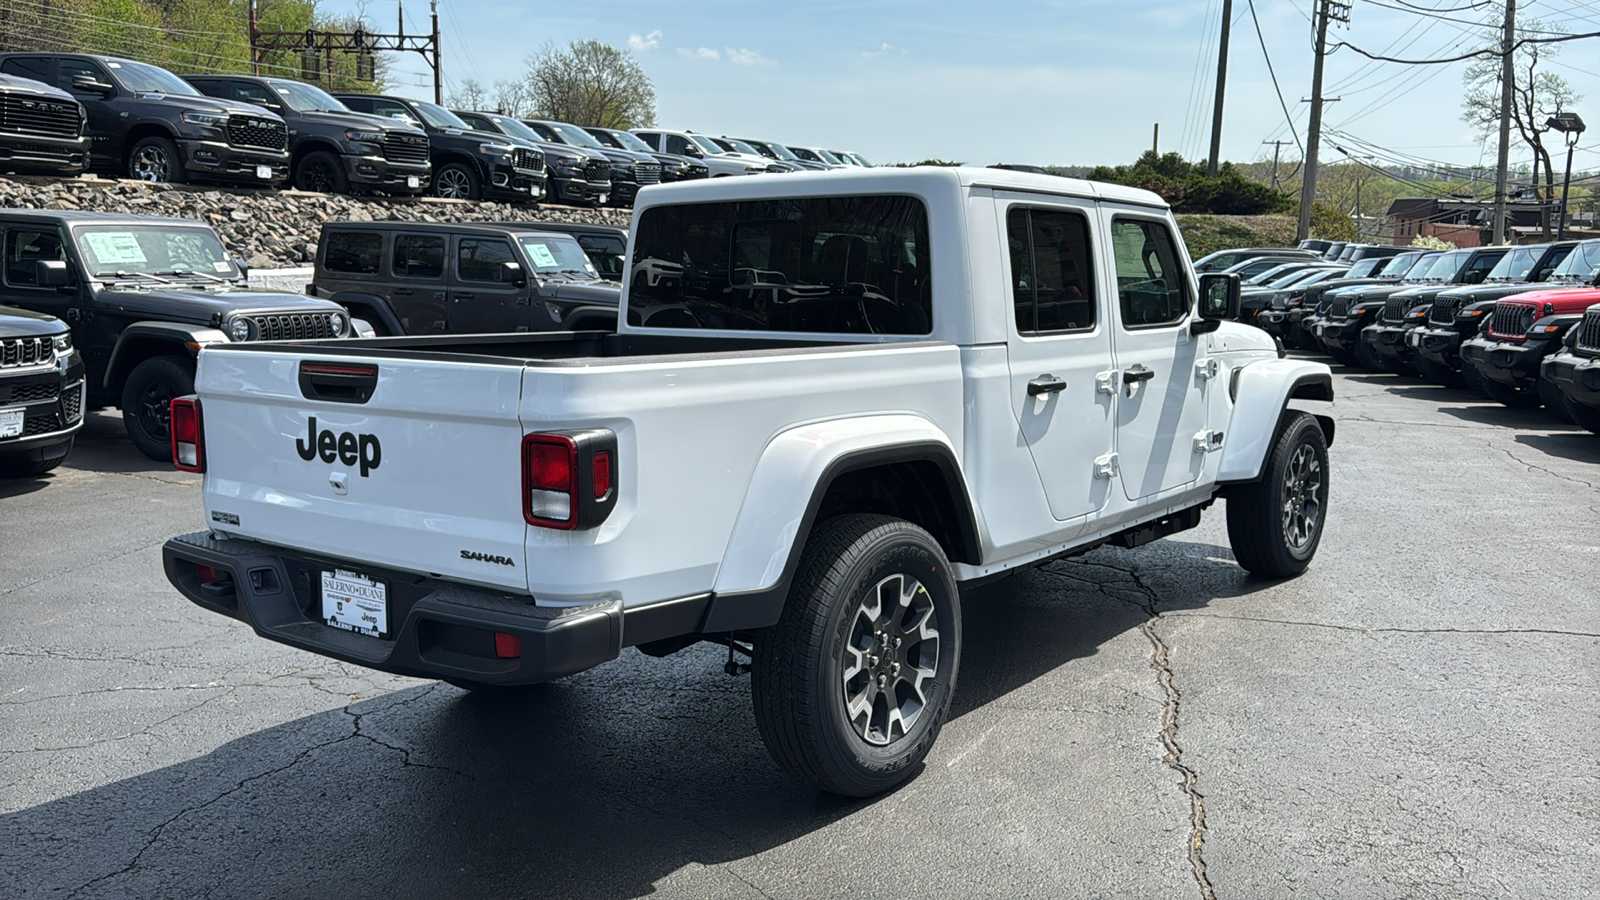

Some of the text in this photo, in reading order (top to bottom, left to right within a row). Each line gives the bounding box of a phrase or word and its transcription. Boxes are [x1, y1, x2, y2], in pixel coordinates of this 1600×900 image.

[248, 120, 276, 130] RAM
[296, 416, 381, 478] Jeep
[460, 550, 516, 567] SAHARA
[323, 579, 384, 601] SALERNO DUANE
[832, 546, 928, 662] BRIDGESTONE
[361, 612, 377, 624] Jeep
[327, 619, 380, 638] SALERNO DUANE
